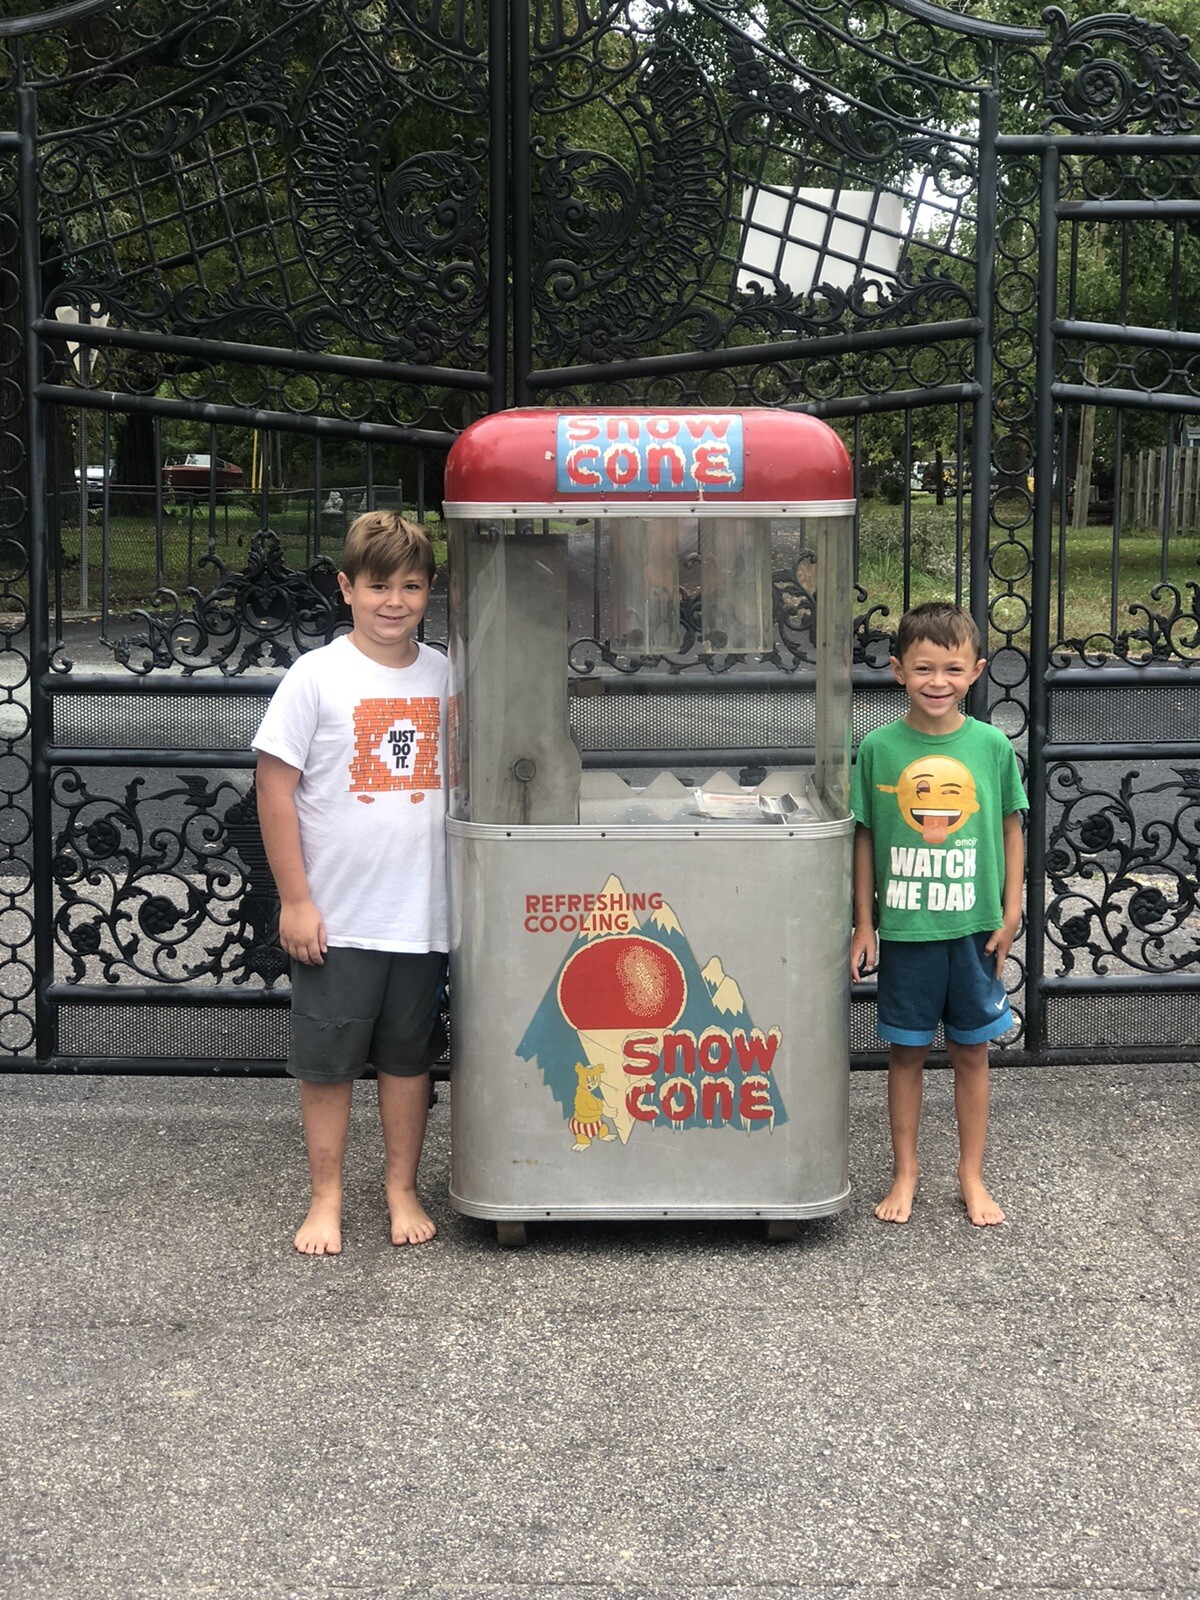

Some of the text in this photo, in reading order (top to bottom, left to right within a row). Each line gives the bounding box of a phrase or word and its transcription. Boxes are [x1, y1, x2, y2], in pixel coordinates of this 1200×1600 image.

[388, 730, 415, 743] JUST
[392, 744, 411, 756] DO
[396, 757, 409, 769] IT.
[891, 846, 977, 879] WATCH
[525, 892, 663, 914] REFRESHING
[886, 880, 977, 911] ME DAB
[524, 914, 629, 933] COOLING
